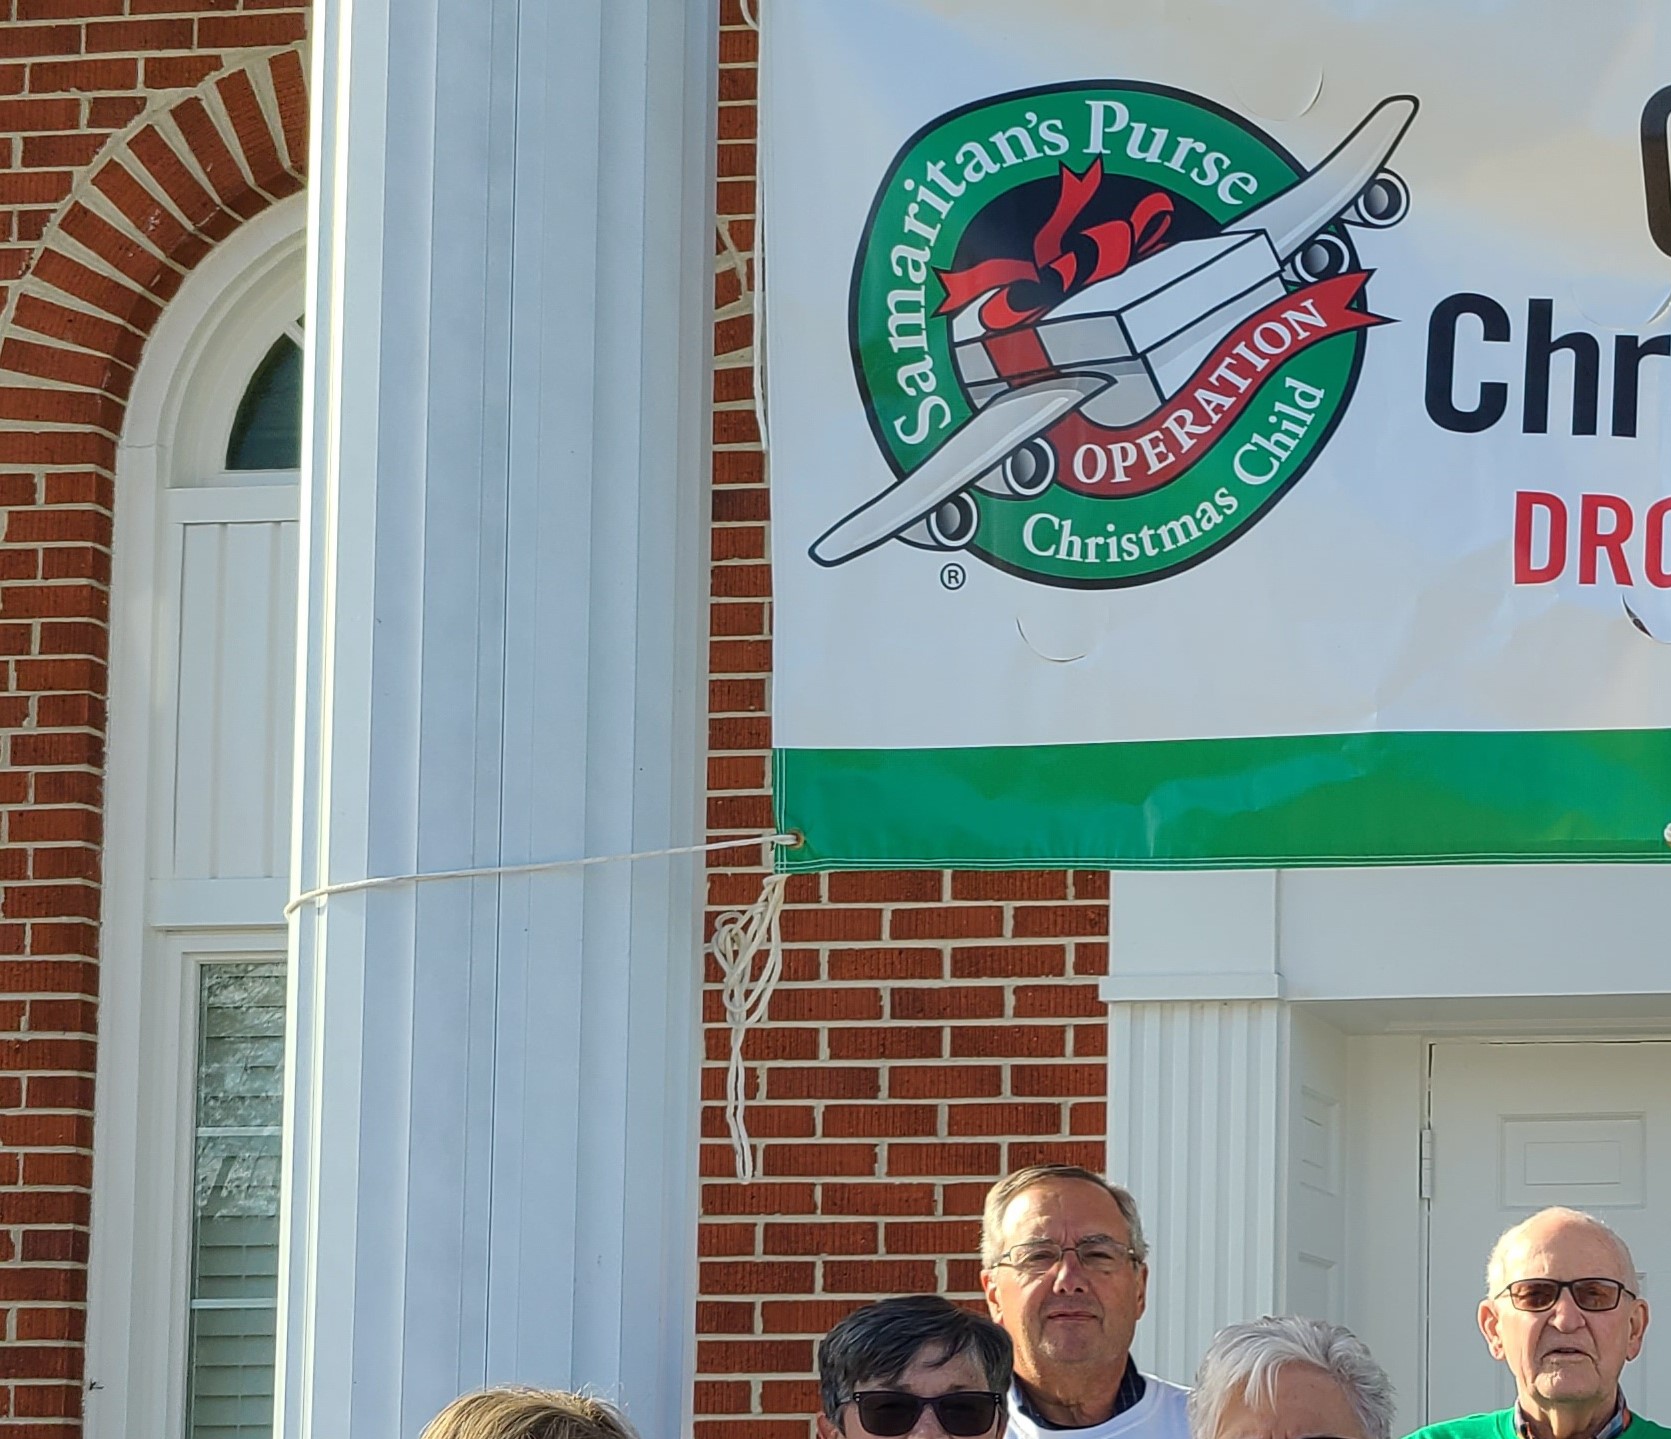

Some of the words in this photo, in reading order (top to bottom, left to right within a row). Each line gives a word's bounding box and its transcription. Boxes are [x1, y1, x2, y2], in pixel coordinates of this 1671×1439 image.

[888, 112, 1069, 444] Samaritan's
[1083, 99, 1258, 206] Purse
[1022, 487, 1239, 564] Christmas
[1233, 376, 1325, 486] Child
[1073, 299, 1328, 484] OPERATION
